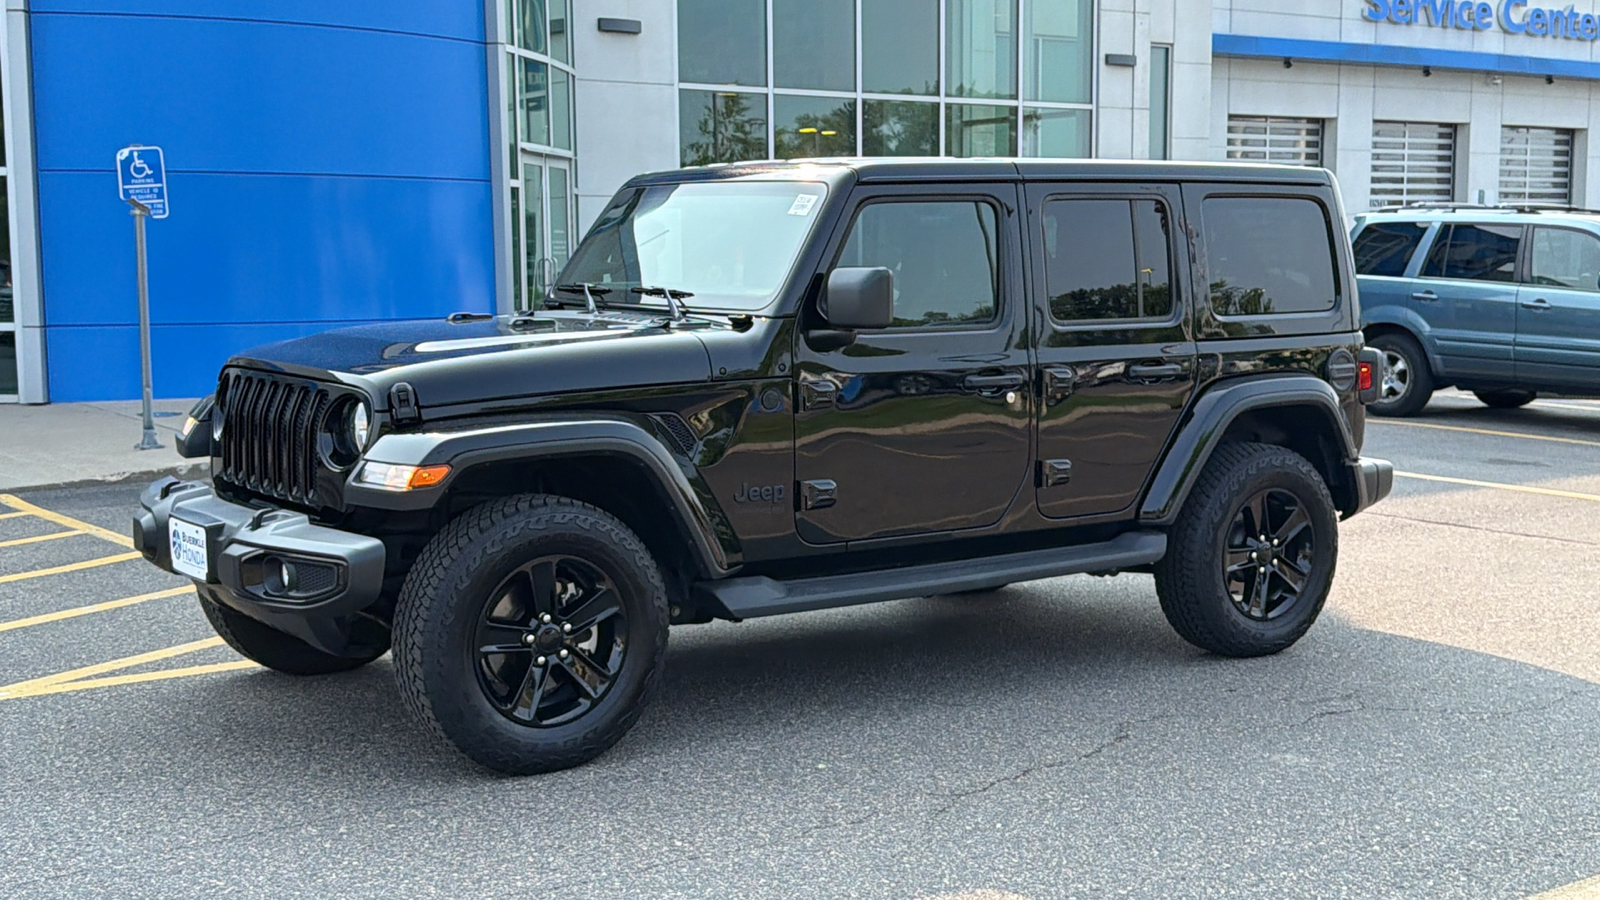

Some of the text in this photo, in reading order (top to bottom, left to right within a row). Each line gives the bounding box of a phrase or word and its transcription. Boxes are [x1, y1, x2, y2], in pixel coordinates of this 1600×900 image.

[1364, 0, 1600, 40] Service Cente
[733, 483, 785, 504] Jeep
[182, 543, 205, 566] HONDA
